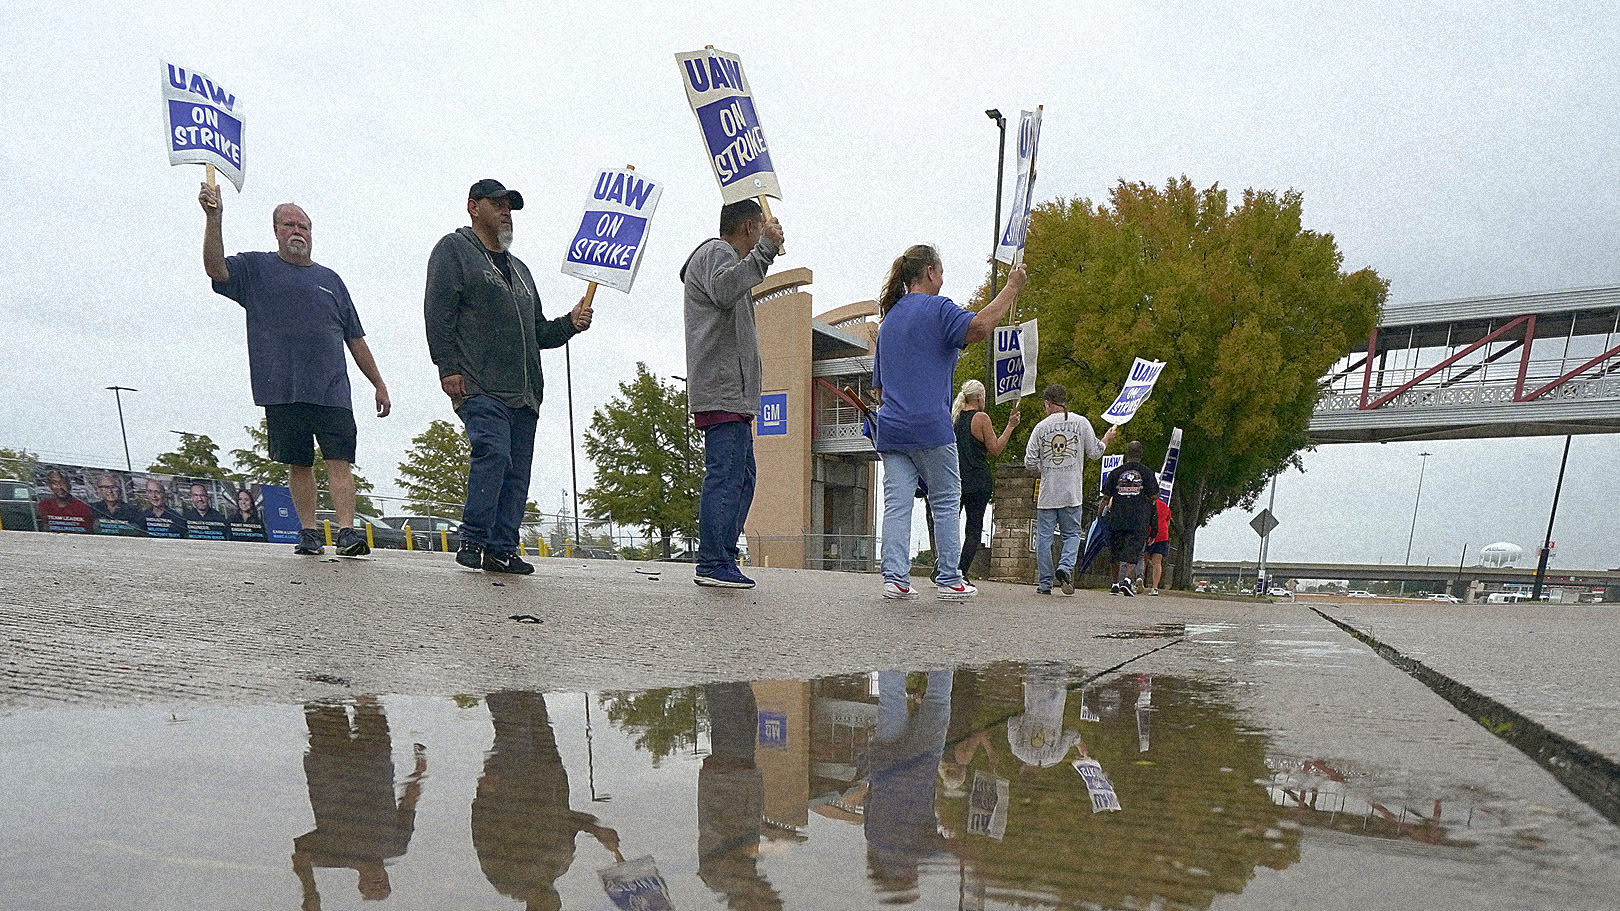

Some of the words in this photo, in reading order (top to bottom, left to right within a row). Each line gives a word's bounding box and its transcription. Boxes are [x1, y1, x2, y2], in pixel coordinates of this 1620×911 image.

[167, 63, 236, 112] UAW
[684, 56, 744, 93] UAW
[191, 106, 219, 129] ON
[720, 99, 747, 138] ON
[174, 125, 241, 164] STRIKE
[714, 126, 767, 183] STRIKE
[593, 171, 656, 211] UAW
[595, 213, 625, 239] ON
[571, 237, 637, 266] STRIKE
[998, 329, 1023, 352] UA
[998, 374, 1022, 393] STRI
[1132, 361, 1163, 383] UAW
[1126, 387, 1142, 400] ON
[763, 403, 780, 421] GM
[1103, 456, 1121, 469] UAW
